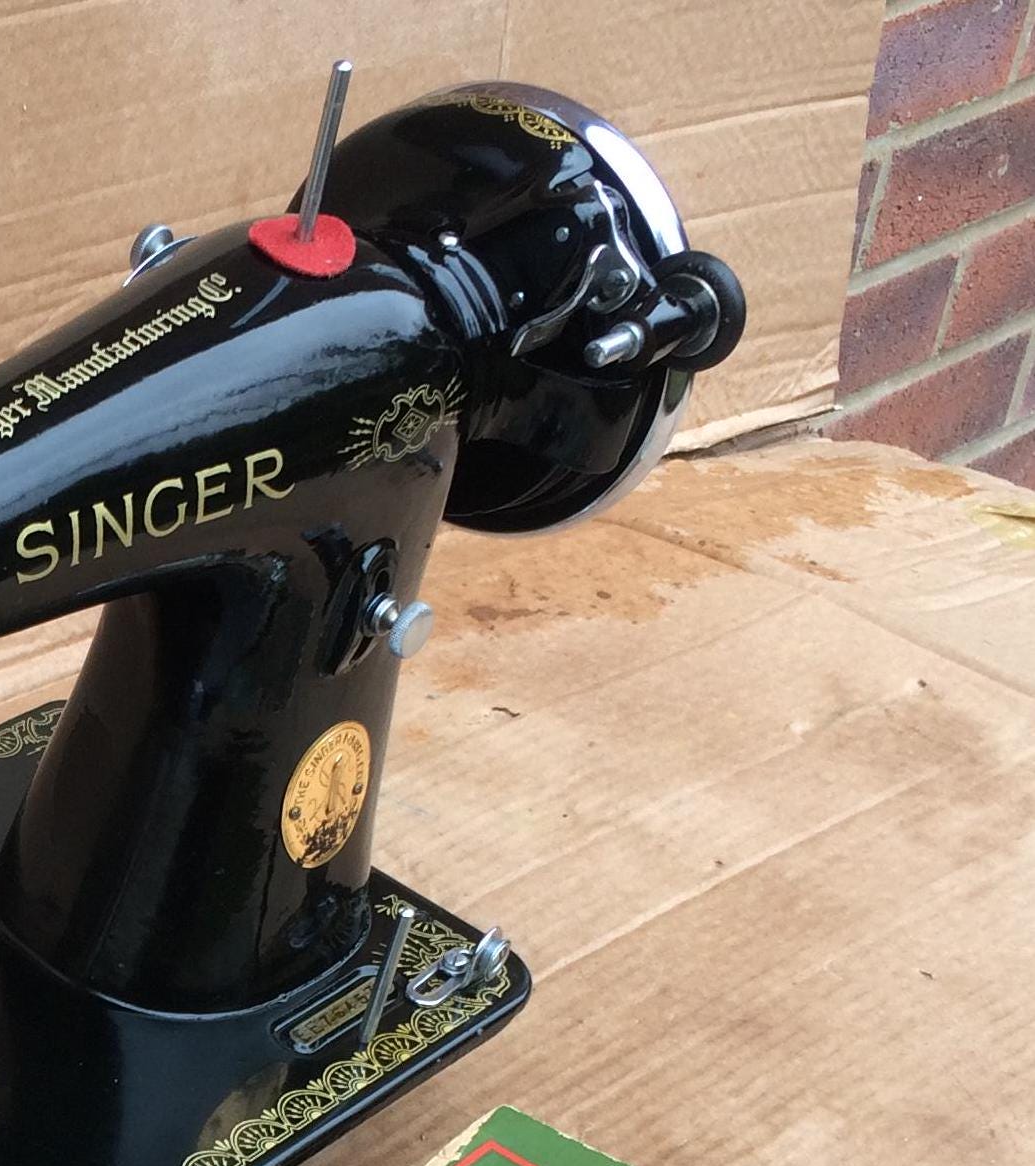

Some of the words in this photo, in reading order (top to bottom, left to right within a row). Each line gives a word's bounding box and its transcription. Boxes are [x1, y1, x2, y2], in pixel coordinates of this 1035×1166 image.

[13, 303, 215, 414] Manufacturing
[14, 447, 296, 586] SINGER
[294, 780, 310, 808] THE
[305, 737, 343, 778] SINGER
